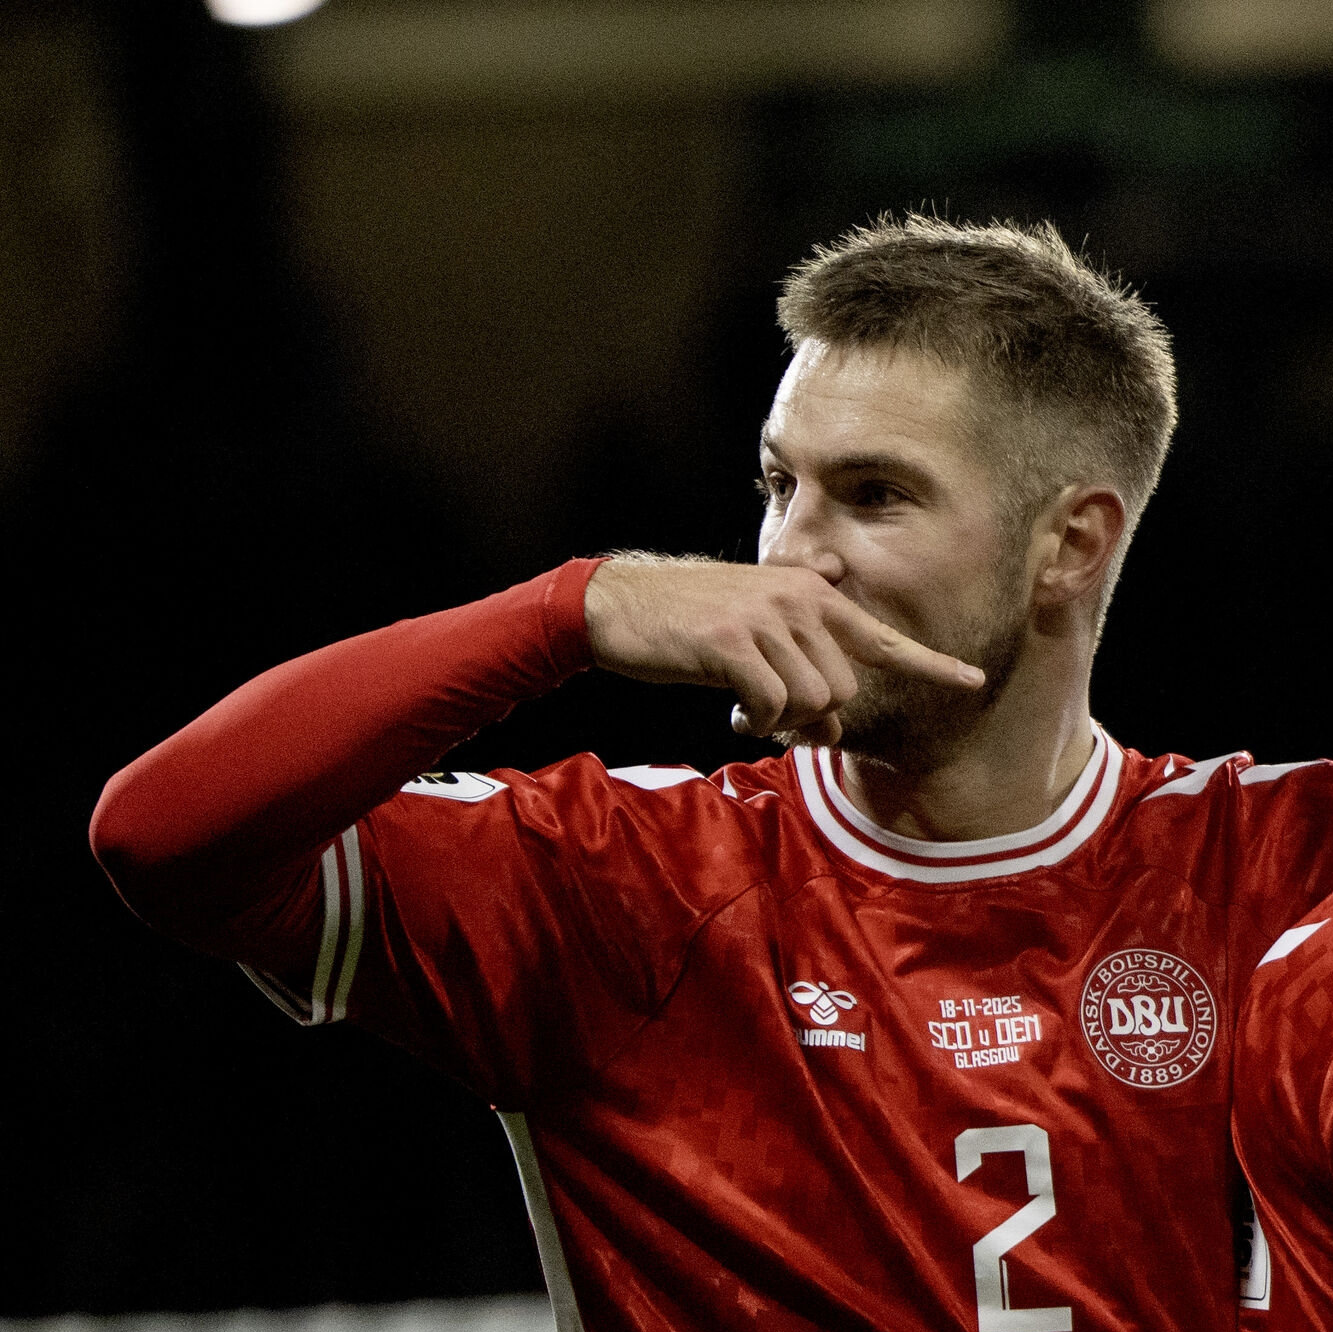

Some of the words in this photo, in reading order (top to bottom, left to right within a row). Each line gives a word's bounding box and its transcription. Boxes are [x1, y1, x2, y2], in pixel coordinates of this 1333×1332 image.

[938, 995, 1022, 1019] 18-11-2025
[1106, 994, 1189, 1036] DBU
[795, 1028, 866, 1052] ummel
[928, 1020, 973, 1050] SCO
[994, 1014, 1041, 1045] DEN
[1085, 987, 1121, 1069] DANSK
[954, 1045, 1020, 1069] GLASGOW
[1128, 1063, 1183, 1084] 1889
